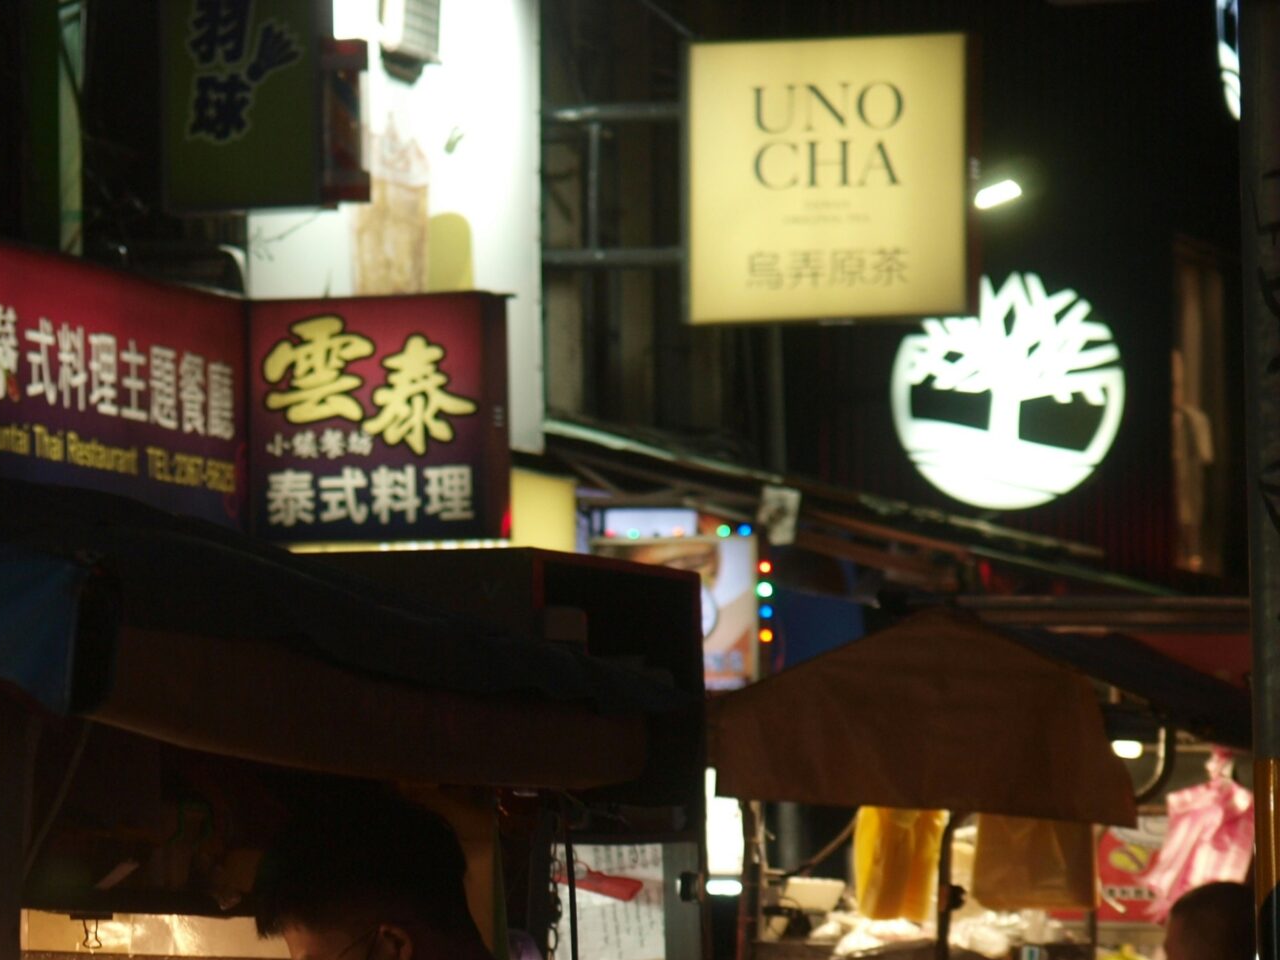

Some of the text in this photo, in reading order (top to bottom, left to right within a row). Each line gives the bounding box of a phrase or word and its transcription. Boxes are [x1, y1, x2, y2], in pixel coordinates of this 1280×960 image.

[752, 81, 904, 134] UNO
[753, 139, 901, 190] CHA
[263, 315, 478, 457] 雲泰
[32, 423, 64, 462] Thai
[66, 430, 139, 476] Restaurant
[266, 463, 476, 528] 泰式料理
